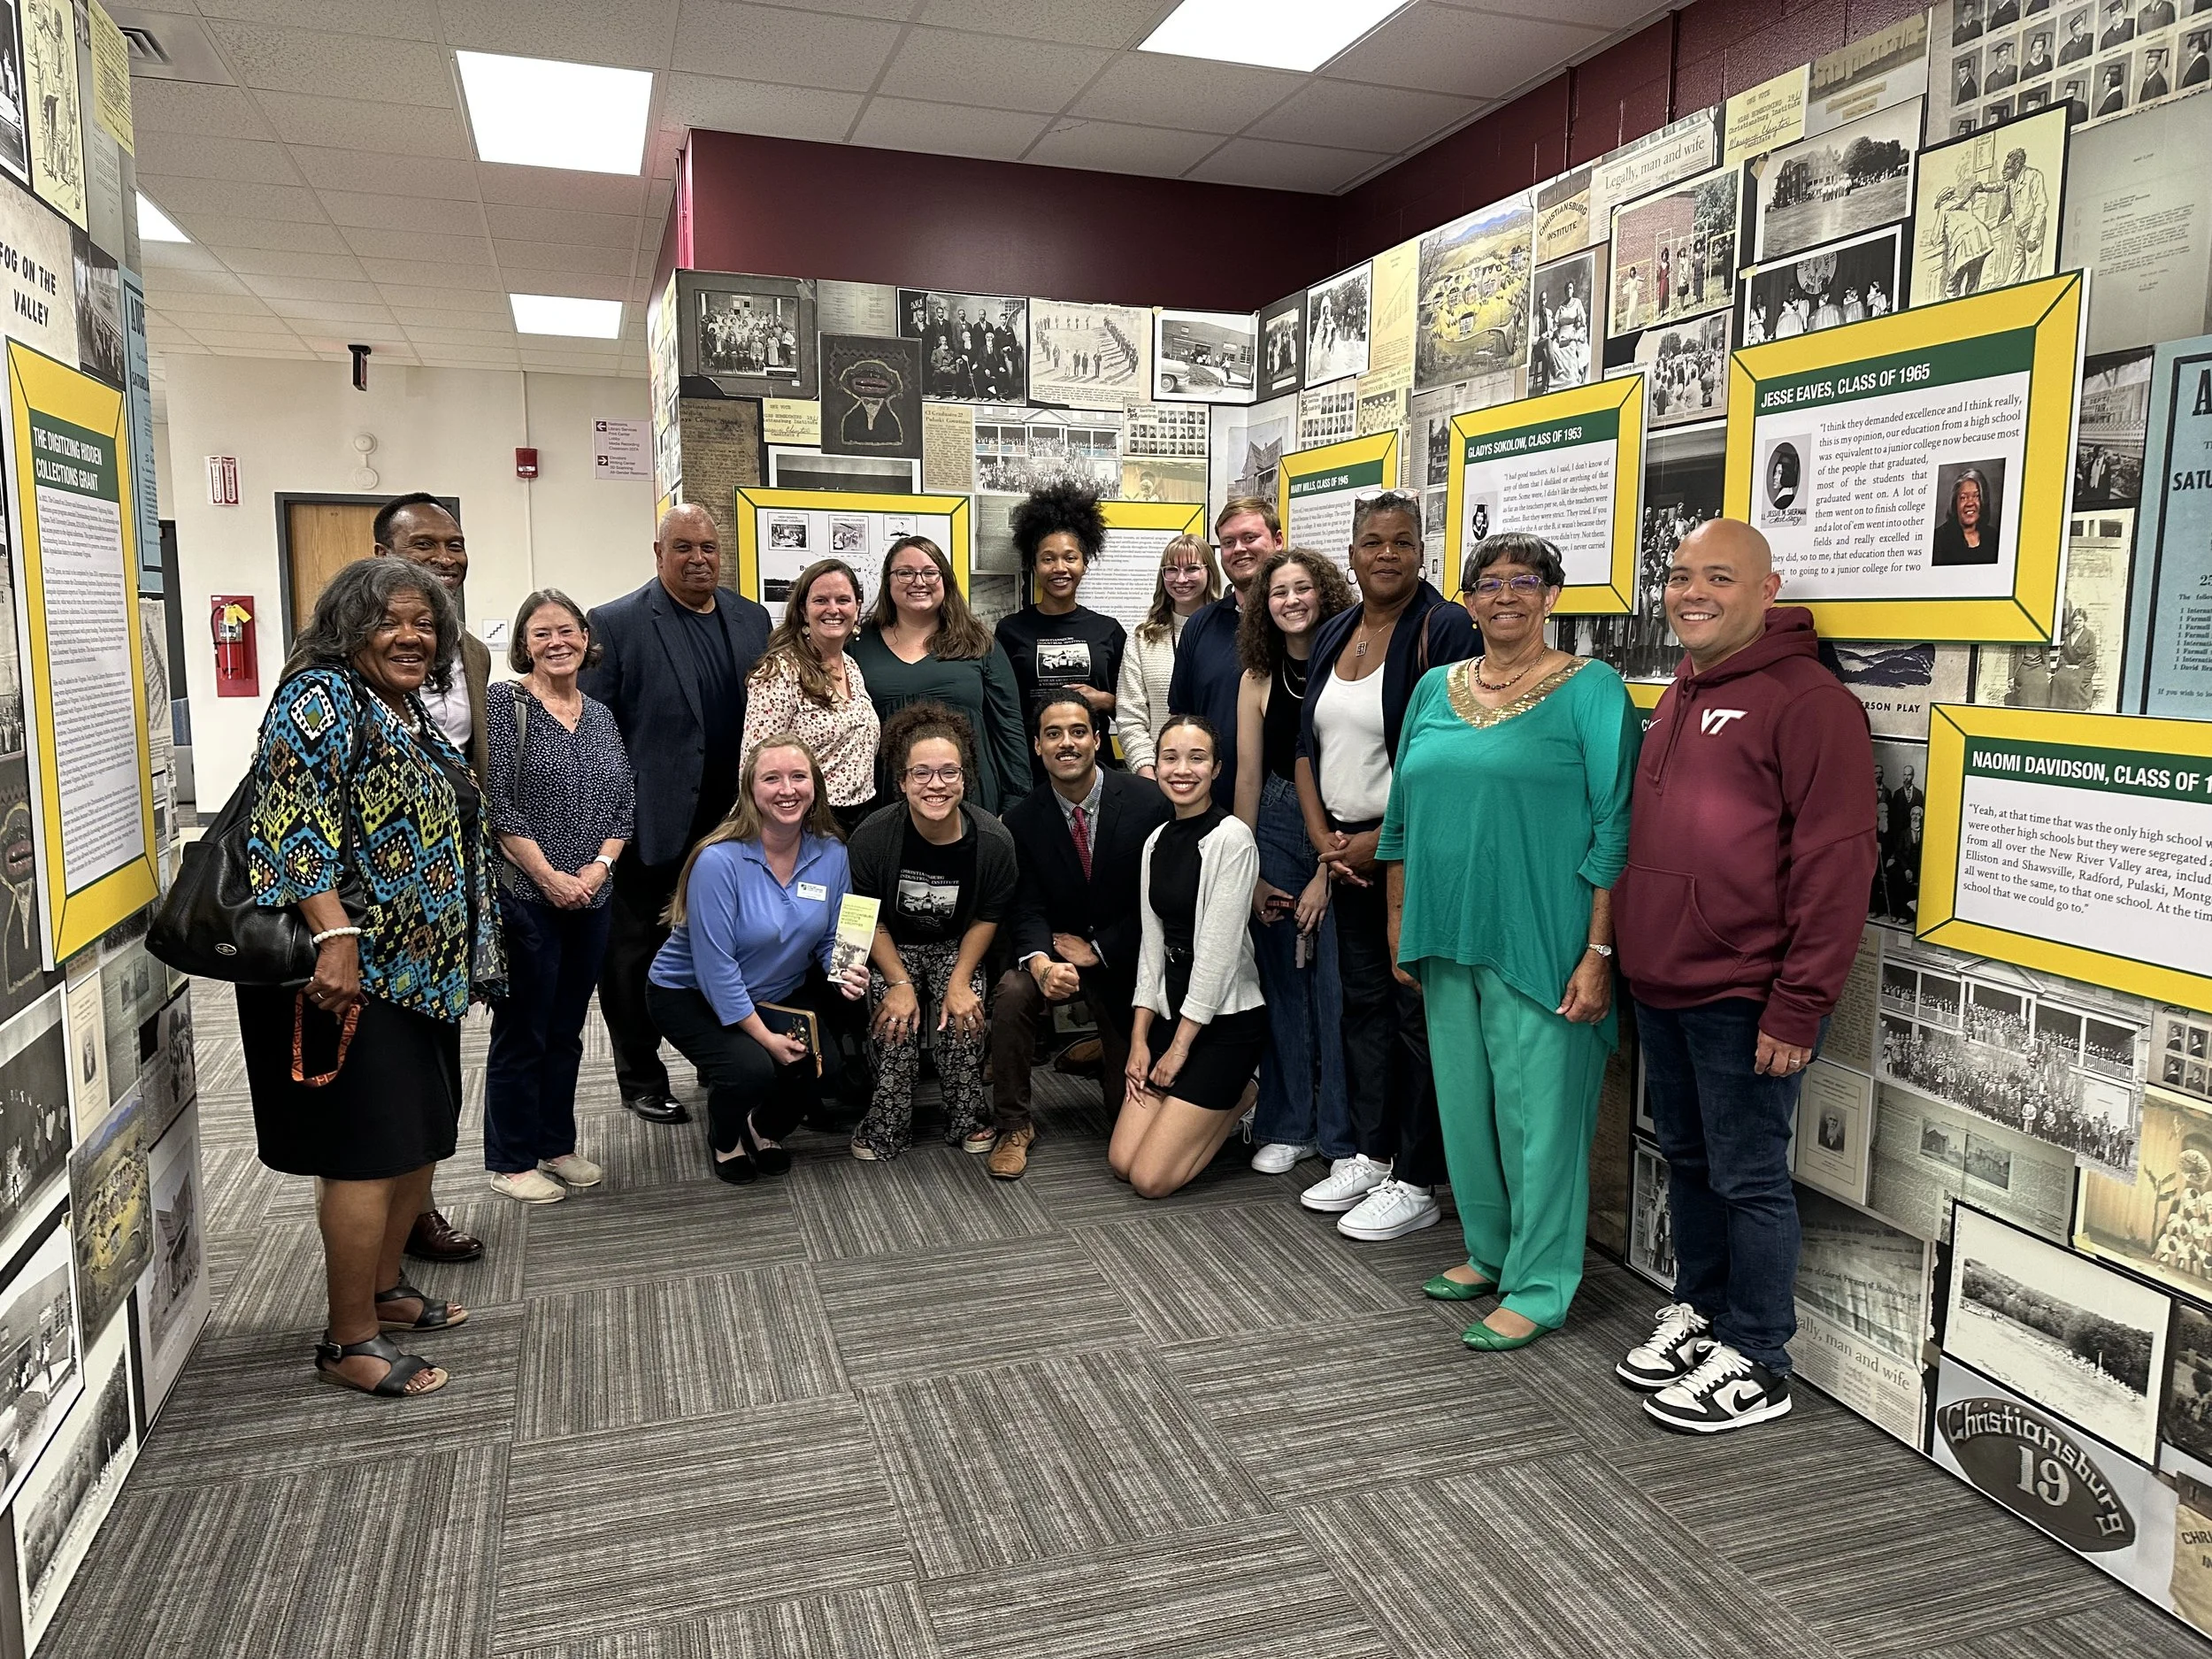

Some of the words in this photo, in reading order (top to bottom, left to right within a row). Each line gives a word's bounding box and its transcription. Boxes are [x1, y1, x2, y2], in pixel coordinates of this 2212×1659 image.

[1605, 165, 1639, 189] Legally,
[1640, 158, 1661, 174] man
[1663, 143, 1681, 165] and
[1685, 135, 1704, 155] wife
[22, 256, 35, 283] ON
[39, 265, 56, 296] THE
[14, 288, 49, 327] VALLEY
[1761, 388, 1794, 408] JESSE
[1796, 381, 1835, 402] EAVES,
[1837, 373, 1877, 395] CLASS
[1878, 370, 1896, 387] OF
[1900, 364, 1931, 383] 1965
[1819, 436, 1832, 447] this
[1833, 435, 1839, 445] is
[1840, 436, 1852, 446] my
[1853, 430, 1885, 444] opinion,
[1901, 422, 1940, 435] education
[1941, 419, 1962, 430] from
[1970, 413, 1990, 428] high
[1991, 409, 2021, 423] school
[1826, 419, 1846, 432] think
[1847, 418, 1863, 430] they
[1863, 411, 1904, 426] demanded
[1904, 407, 1946, 420] excellence
[1947, 402, 1962, 414] and
[1964, 401, 1968, 411] I
[1969, 397, 1993, 411] think
[1994, 394, 2022, 407] really,
[33, 426, 46, 449] THE
[48, 431, 80, 459] DIGITIZING
[81, 442, 103, 465] HIDDEN
[1468, 443, 1493, 458] GLADYS
[1493, 437, 1526, 454] SOKOLOW,
[1527, 433, 1551, 448] CLASS
[1552, 430, 1563, 443] OF
[1563, 426, 1582, 442] 1953
[35, 458, 78, 487] COLLECTIONS
[79, 469, 98, 491] GRANT
[1317, 478, 1330, 489] CLASS
[1331, 476, 1337, 487] OF
[1701, 708, 1748, 735] VT
[1862, 702, 1891, 710] RSON
[1897, 703, 1920, 712] PLAY
[1972, 751, 2021, 772] NAOMI
[2024, 757, 2110, 786] DAVIDSON,
[2114, 765, 2170, 788] CLASS
[2175, 772, 2200, 792] OF
[1968, 822, 1990, 832] were
[1990, 823, 2016, 836] other
[2016, 826, 2038, 841] high
[2039, 831, 2075, 846] schools
[2077, 835, 2093, 849] but
[2095, 839, 2118, 856] they
[2120, 846, 2147, 857] were
[2148, 850, 2207, 867] segregated
[1998, 809, 2008, 818] at
[2008, 809, 2027, 821] that
[2029, 811, 2051, 825] time
[2053, 814, 2072, 827] that
[2074, 821, 2093, 830] was
[2095, 820, 2112, 833] the
[2113, 824, 2138, 840] only
[2139, 826, 2163, 842] high
[2166, 831, 2202, 846] school
[1965, 848, 1999, 864] Elliston
[2001, 856, 2019, 867] and
[2021, 858, 2075, 880] Shawsville,
[2078, 868, 2123, 889] Radford,
[2127, 877, 2169, 898] Pulaski,
[1966, 833, 1988, 846] from
[1991, 838, 2002, 849] all
[2005, 842, 2027, 853] over
[2030, 844, 2046, 856] the
[2049, 846, 2072, 861] New
[2076, 850, 2104, 866] River
[2109, 856, 2141, 876] Valley
[2145, 866, 2171, 879] area,
[1962, 880, 1991, 895] school
[1993, 886, 2011, 899] that
[2013, 893, 2026, 902] we
[2028, 895, 2055, 908] could
[2055, 902, 2069, 912] go
[1826, 1334, 1852, 1356] man
[1855, 1348, 1878, 1373] and
[1883, 1363, 1910, 1391] wife
[1947, 1402, 2125, 1537] Christiansburg
[2017, 1444, 2070, 1507] 19
